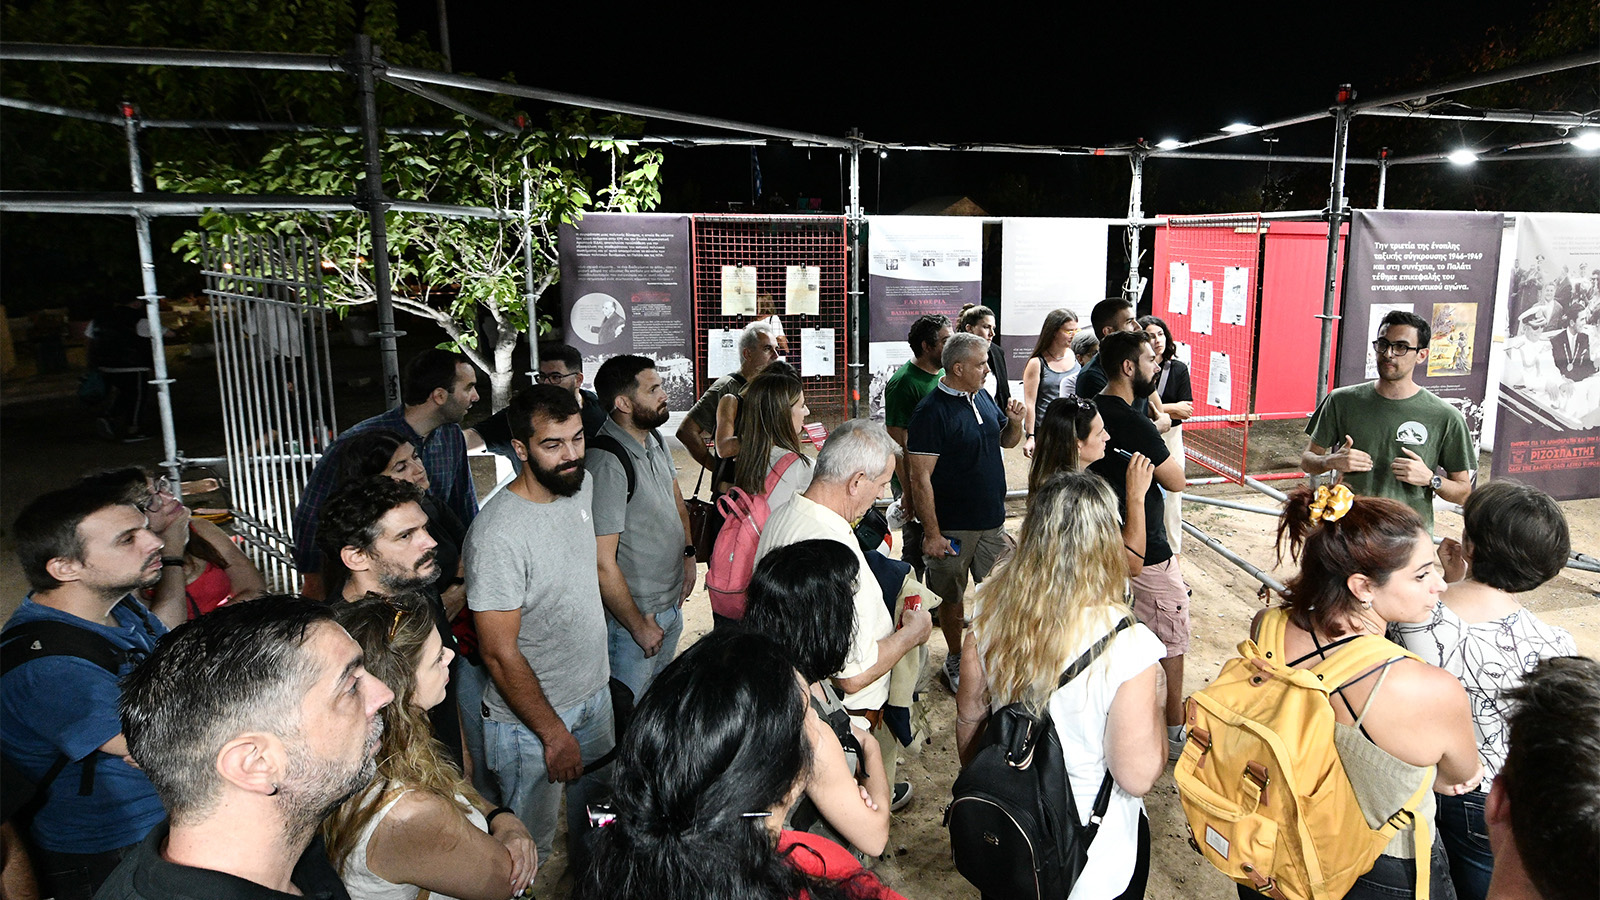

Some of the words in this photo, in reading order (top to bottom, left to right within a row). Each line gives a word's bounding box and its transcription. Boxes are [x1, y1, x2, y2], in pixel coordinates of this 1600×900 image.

[1374, 242, 1389, 250] Την
[1390, 241, 1416, 250] τριετία
[1417, 243, 1430, 251] της
[1431, 241, 1460, 251] ένοπλης
[1374, 252, 1402, 261] ταξικής
[1403, 252, 1447, 261] σύγκρουσης
[1402, 262, 1436, 271] συνέχεια,
[1446, 262, 1472, 270] Παλάτι
[1372, 273, 1398, 281] τέθηκε
[1399, 273, 1441, 281] επικεφαλής
[1371, 283, 1443, 292] αντικομμουνιστικού
[1444, 283, 1469, 292] αγώνα.
[1530, 446, 1595, 460] ΡΙΖΟΣΠΑΣΤΗΣ
